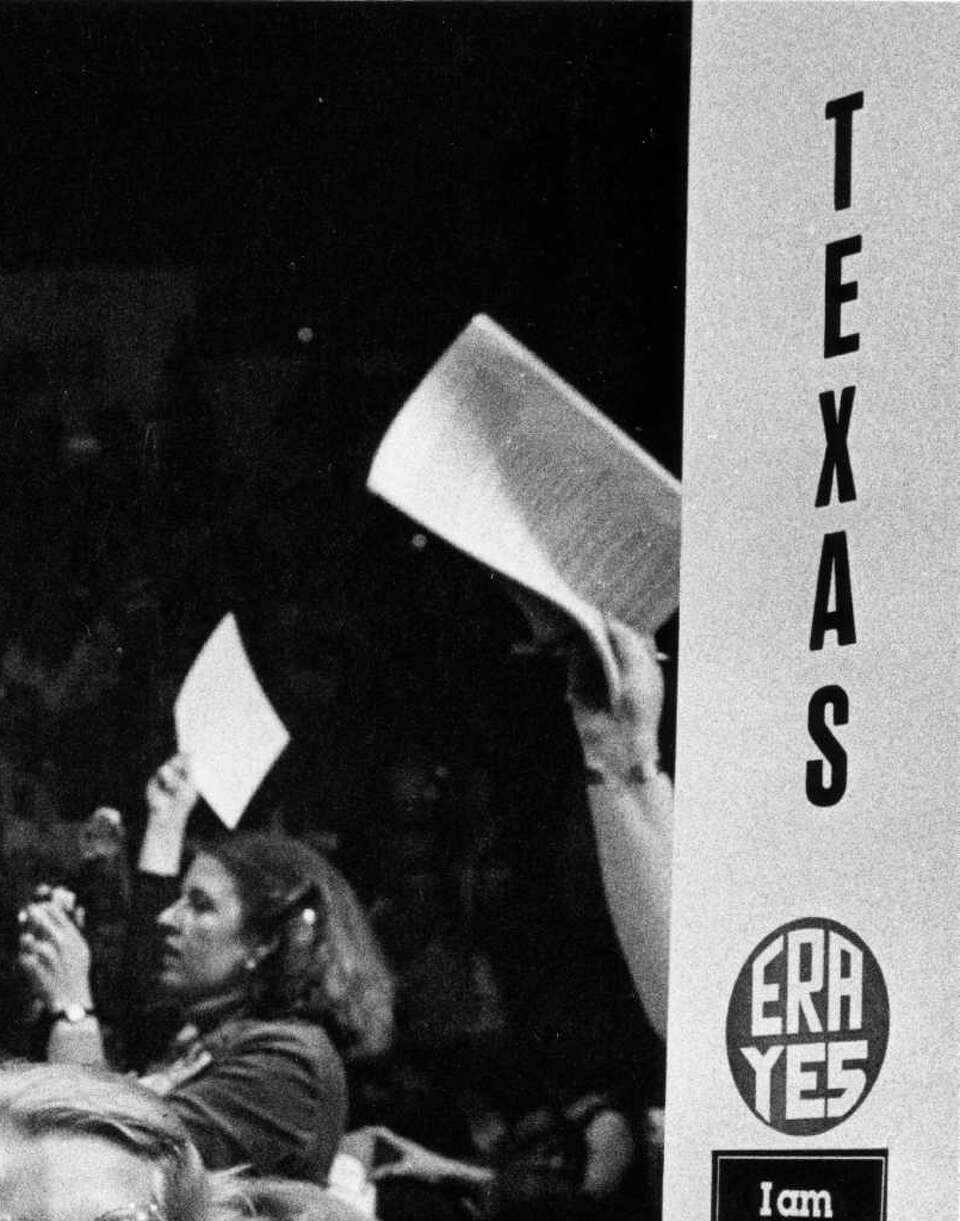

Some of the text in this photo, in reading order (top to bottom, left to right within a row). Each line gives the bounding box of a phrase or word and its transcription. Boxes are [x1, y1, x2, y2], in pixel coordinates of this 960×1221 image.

[805, 90, 864, 808] TEXAS
[750, 928, 863, 1037] ERA
[740, 1038, 869, 1123] YES
[759, 1181, 833, 1218] I am
